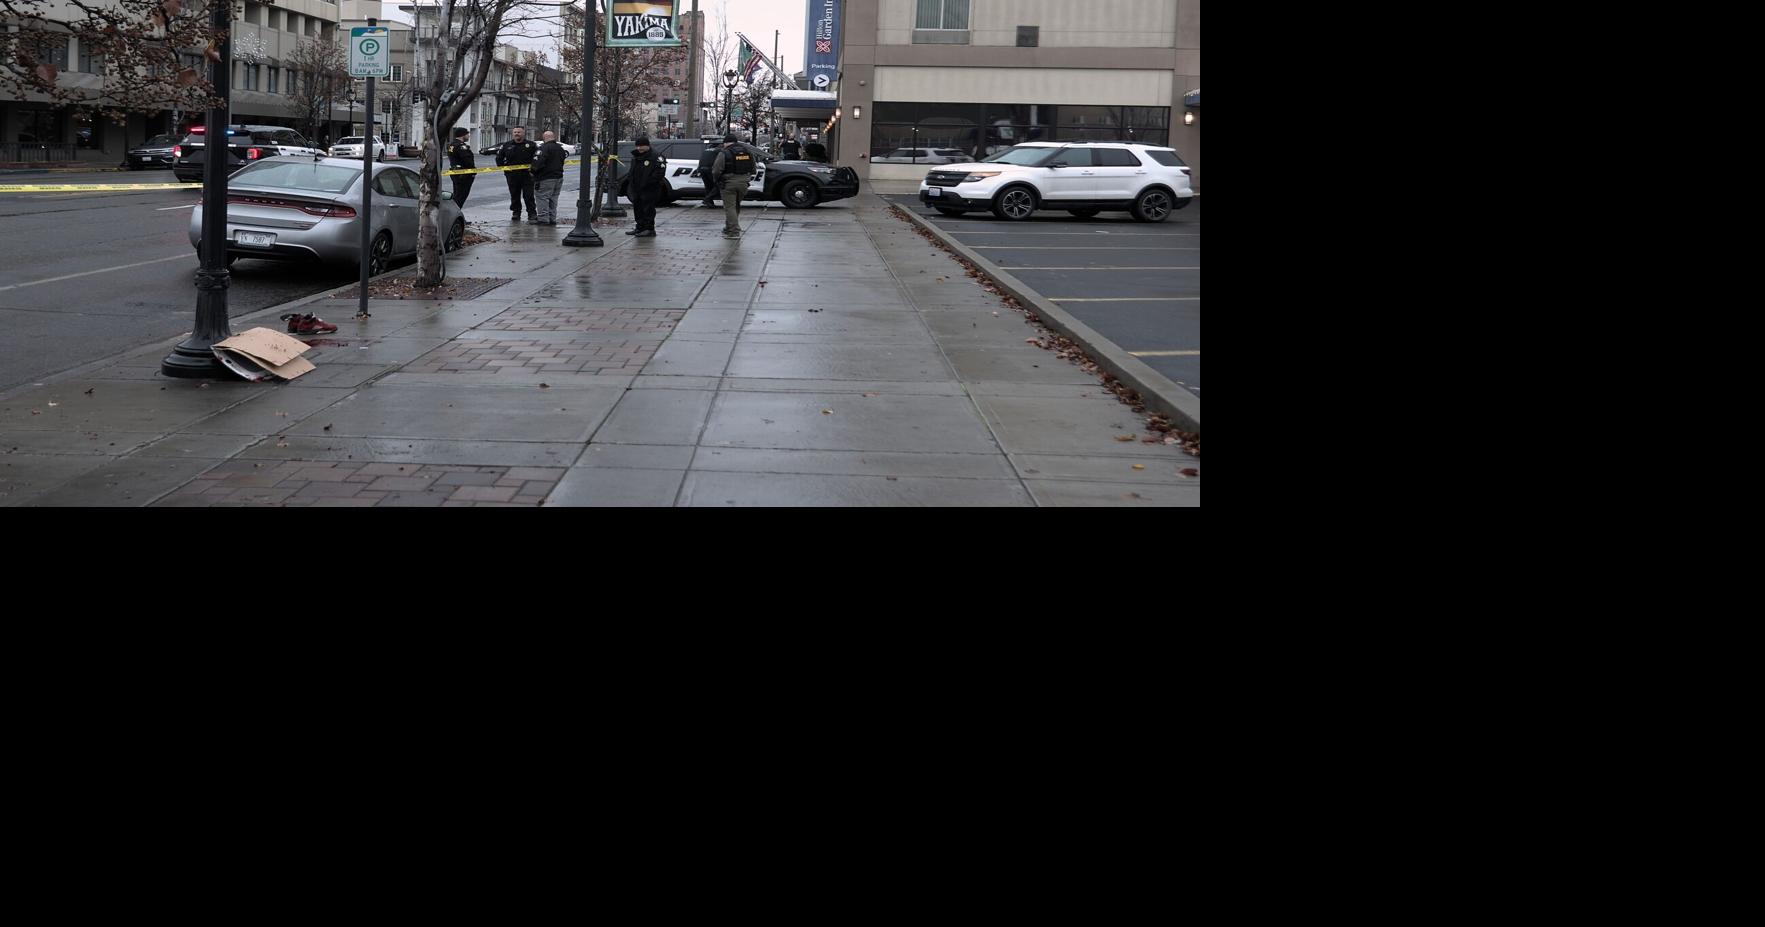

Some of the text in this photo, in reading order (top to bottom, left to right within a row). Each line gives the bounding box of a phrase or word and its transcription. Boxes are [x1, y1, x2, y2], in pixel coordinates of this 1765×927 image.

[614, 13, 670, 37] YAKIMA
[816, 19, 824, 40] Hilton
[823, 8, 833, 40] Garden
[366, 43, 375, 52] P
